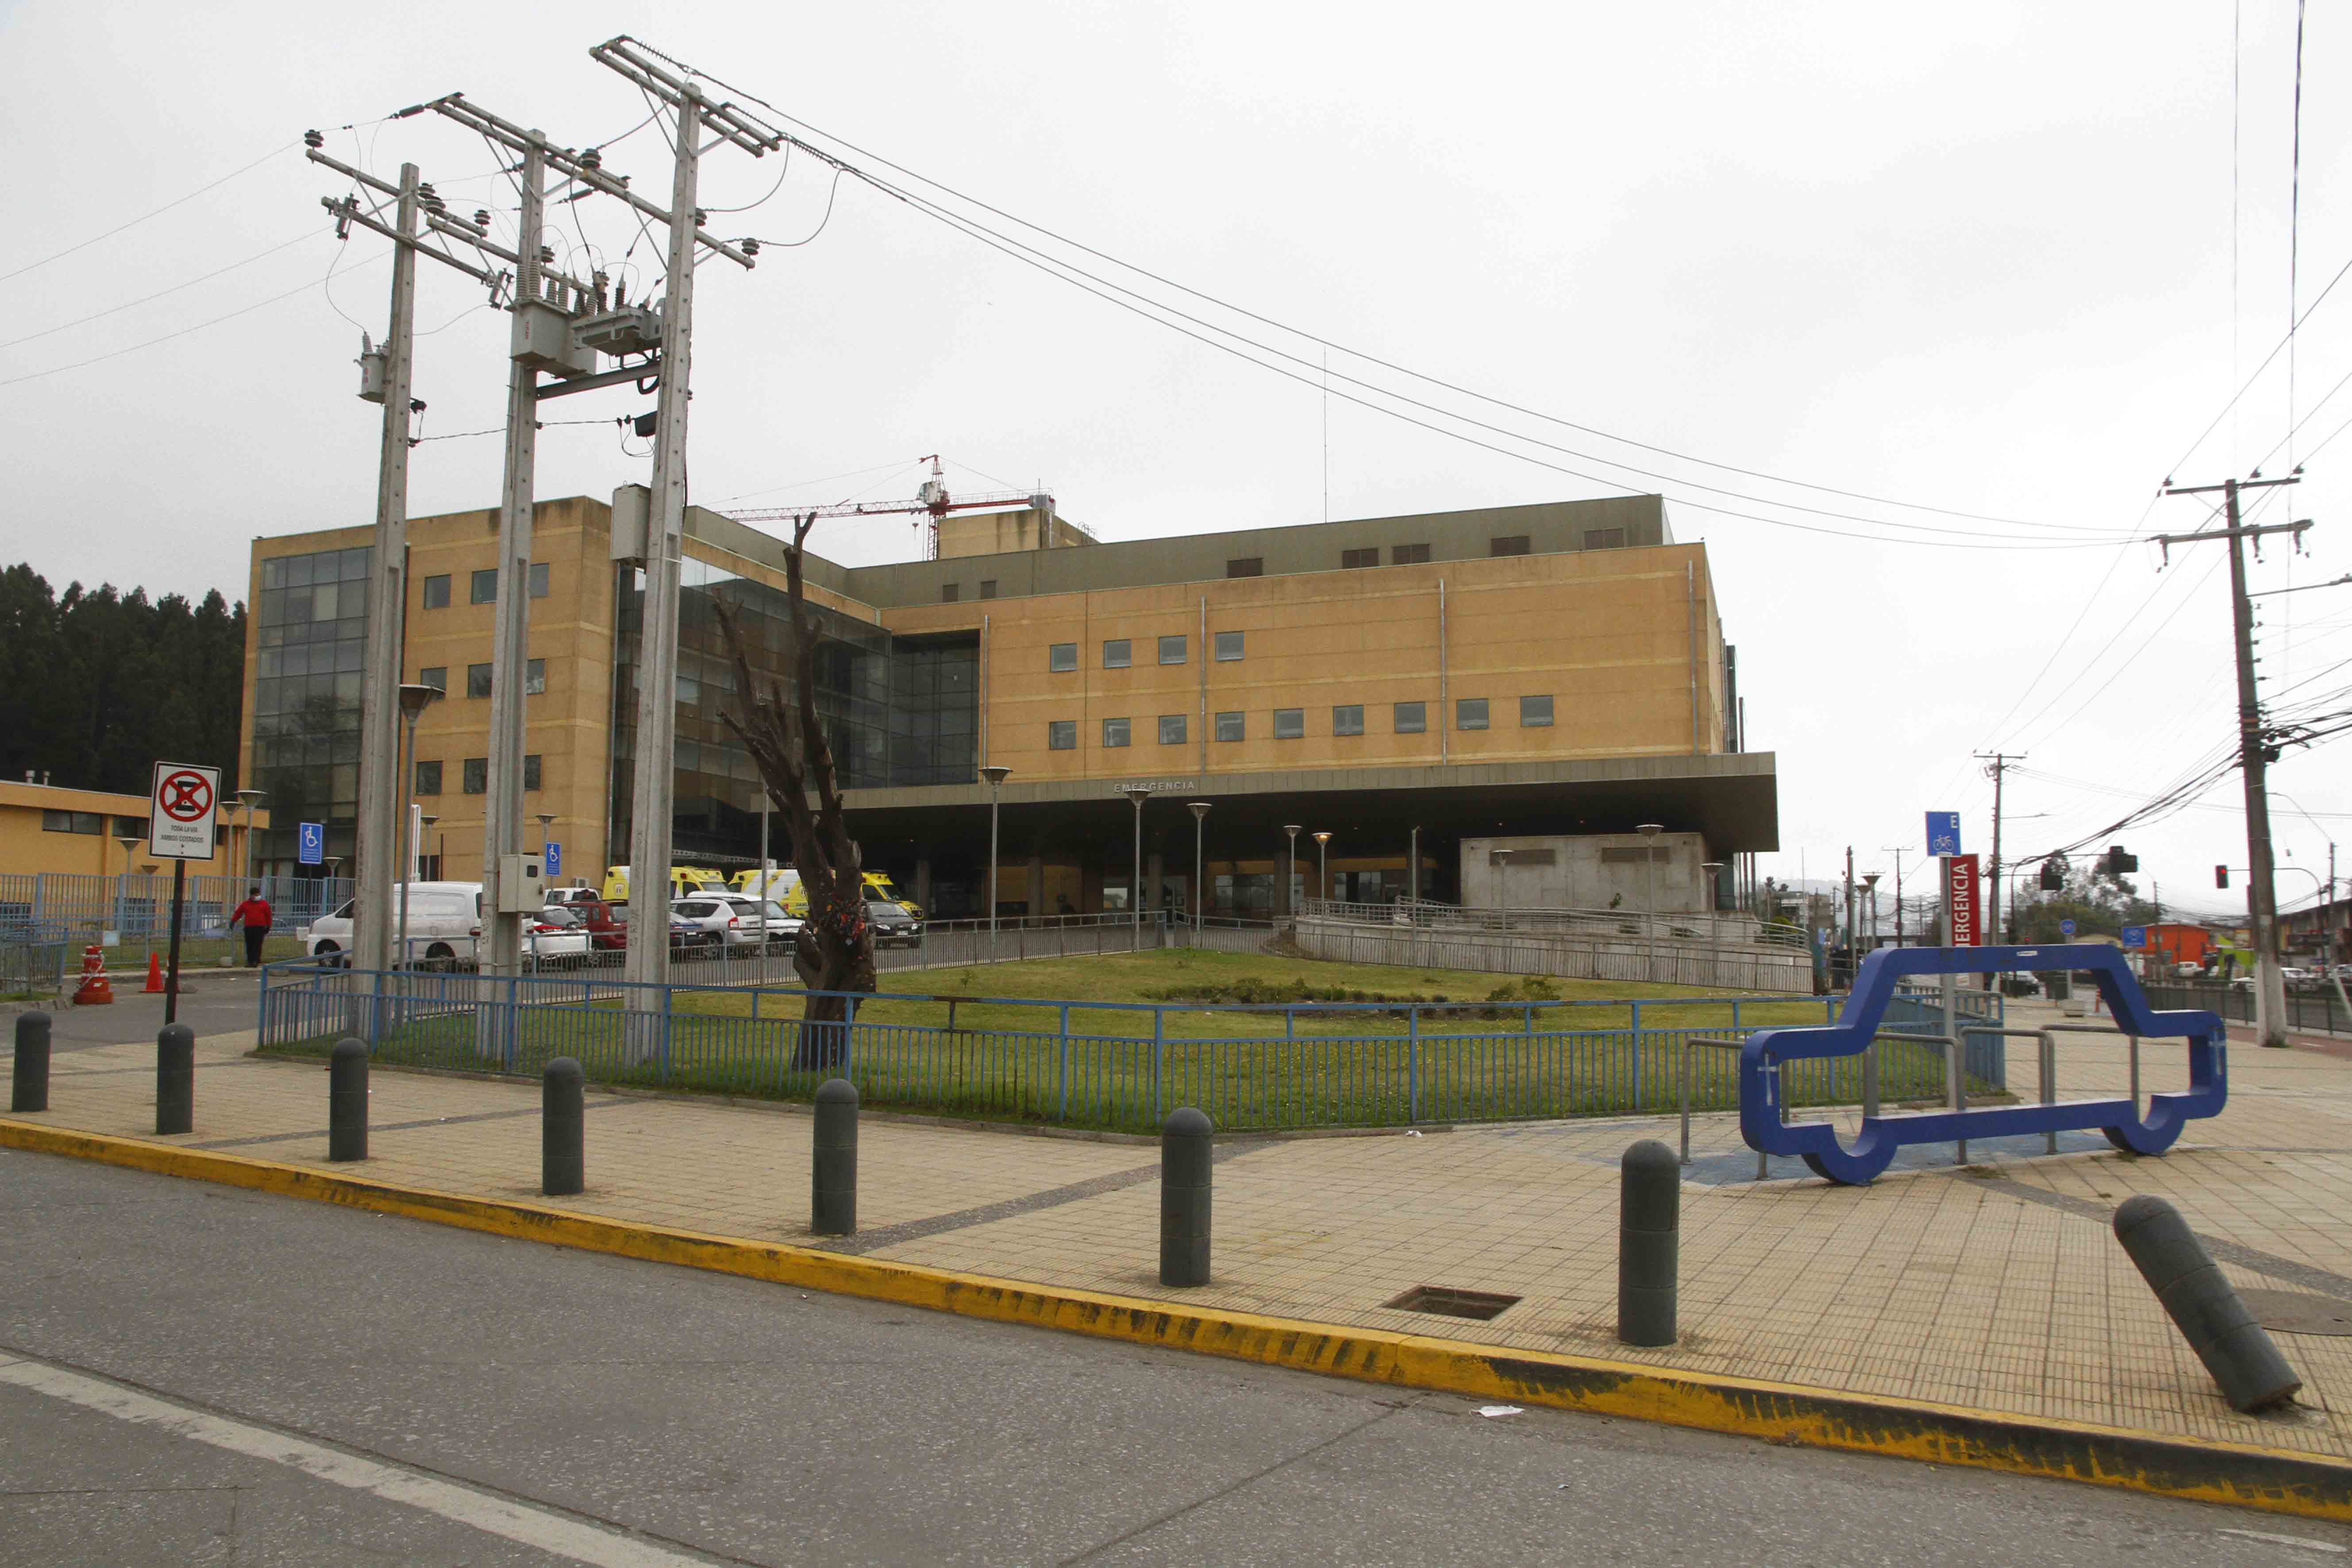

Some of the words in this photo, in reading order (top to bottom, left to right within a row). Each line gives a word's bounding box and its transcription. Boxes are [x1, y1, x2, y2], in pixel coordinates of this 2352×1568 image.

[1114, 781, 1195, 793] EMERGENCIA
[1950, 815, 1958, 828] E
[1952, 863, 1971, 947] ERGENCIA
